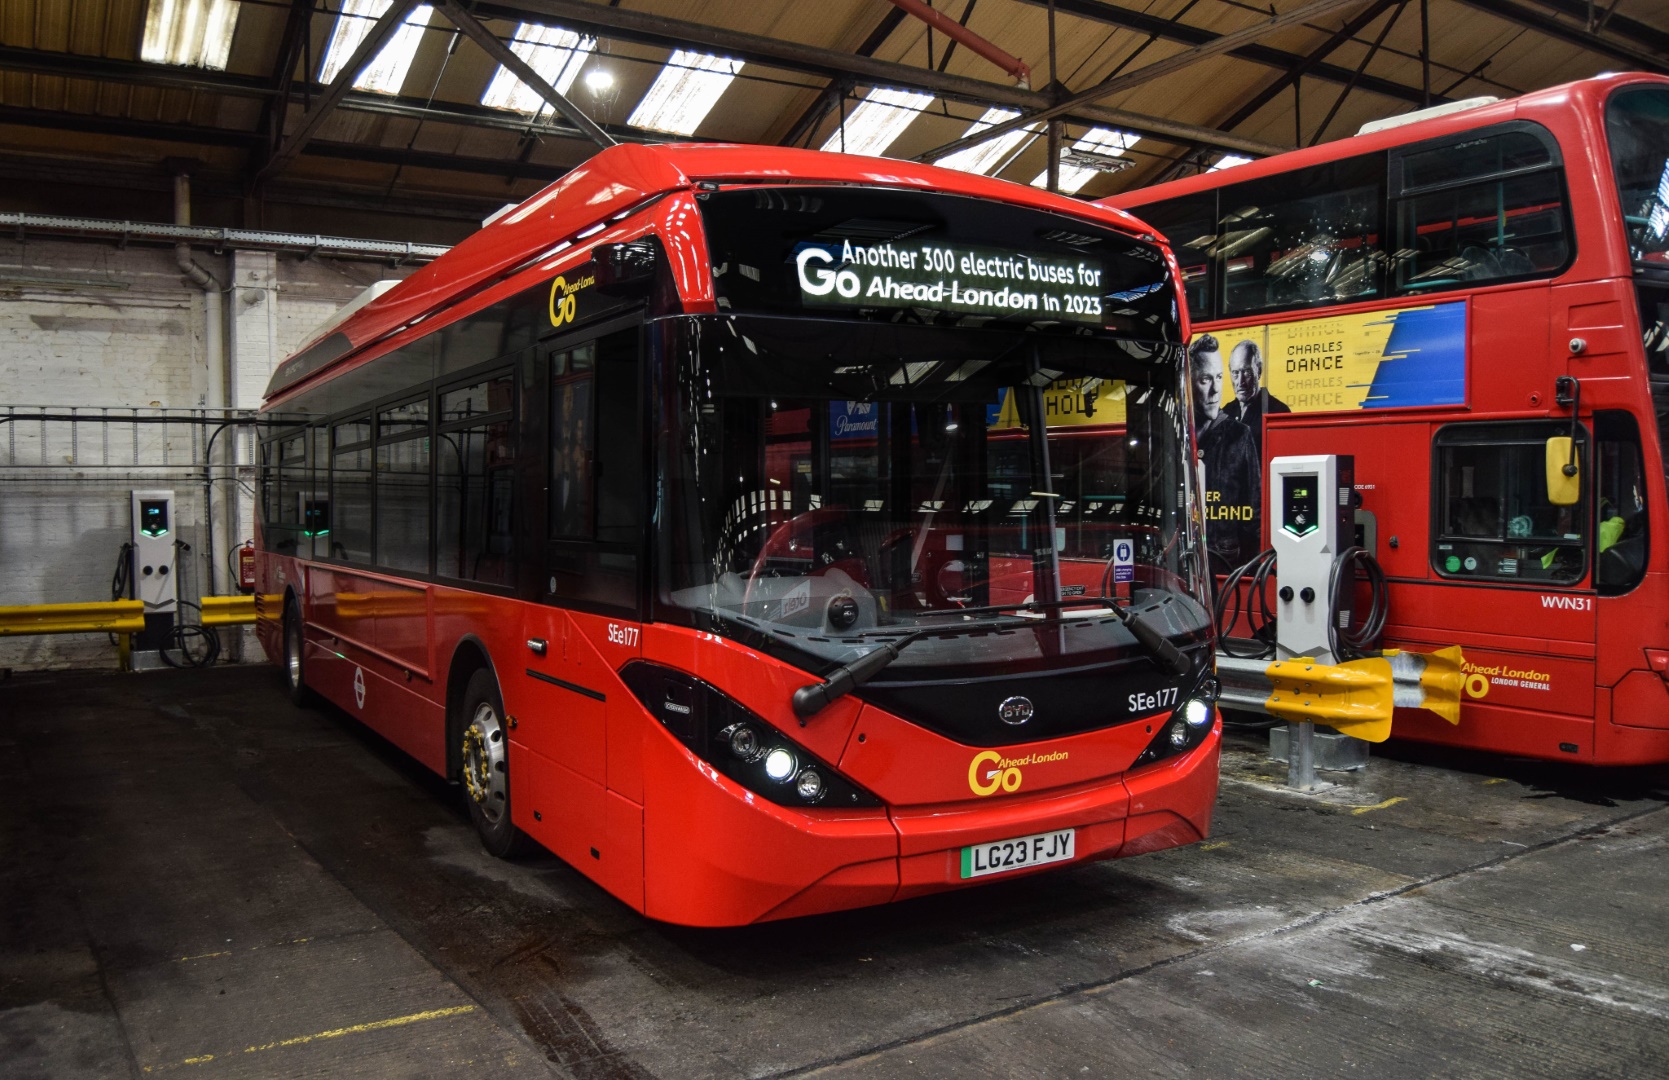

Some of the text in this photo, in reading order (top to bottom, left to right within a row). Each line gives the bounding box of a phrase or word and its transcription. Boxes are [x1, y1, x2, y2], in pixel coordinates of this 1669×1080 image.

[796, 247, 860, 298] Go
[842, 239, 1101, 287] Another 300 electric buses for
[549, 275, 576, 327] Go
[866, 275, 1102, 316] Ahead-London in 2023
[1287, 341, 1343, 356] CHARLES
[1286, 355, 1344, 373] DANCE
[1287, 376, 1343, 391] CHARLES
[1286, 392, 1344, 407] DANCE
[1541, 595, 1592, 611] WVN31
[607, 623, 639, 647] SEe177
[1461, 662, 1550, 682] Ahead-London
[1491, 677, 1551, 691] LONDON GENERAL
[1128, 687, 1179, 713] SEe177
[998, 750, 1069, 769] Ahead-London
[968, 750, 1022, 796] Go
[974, 833, 1071, 871] LG23 FJY
